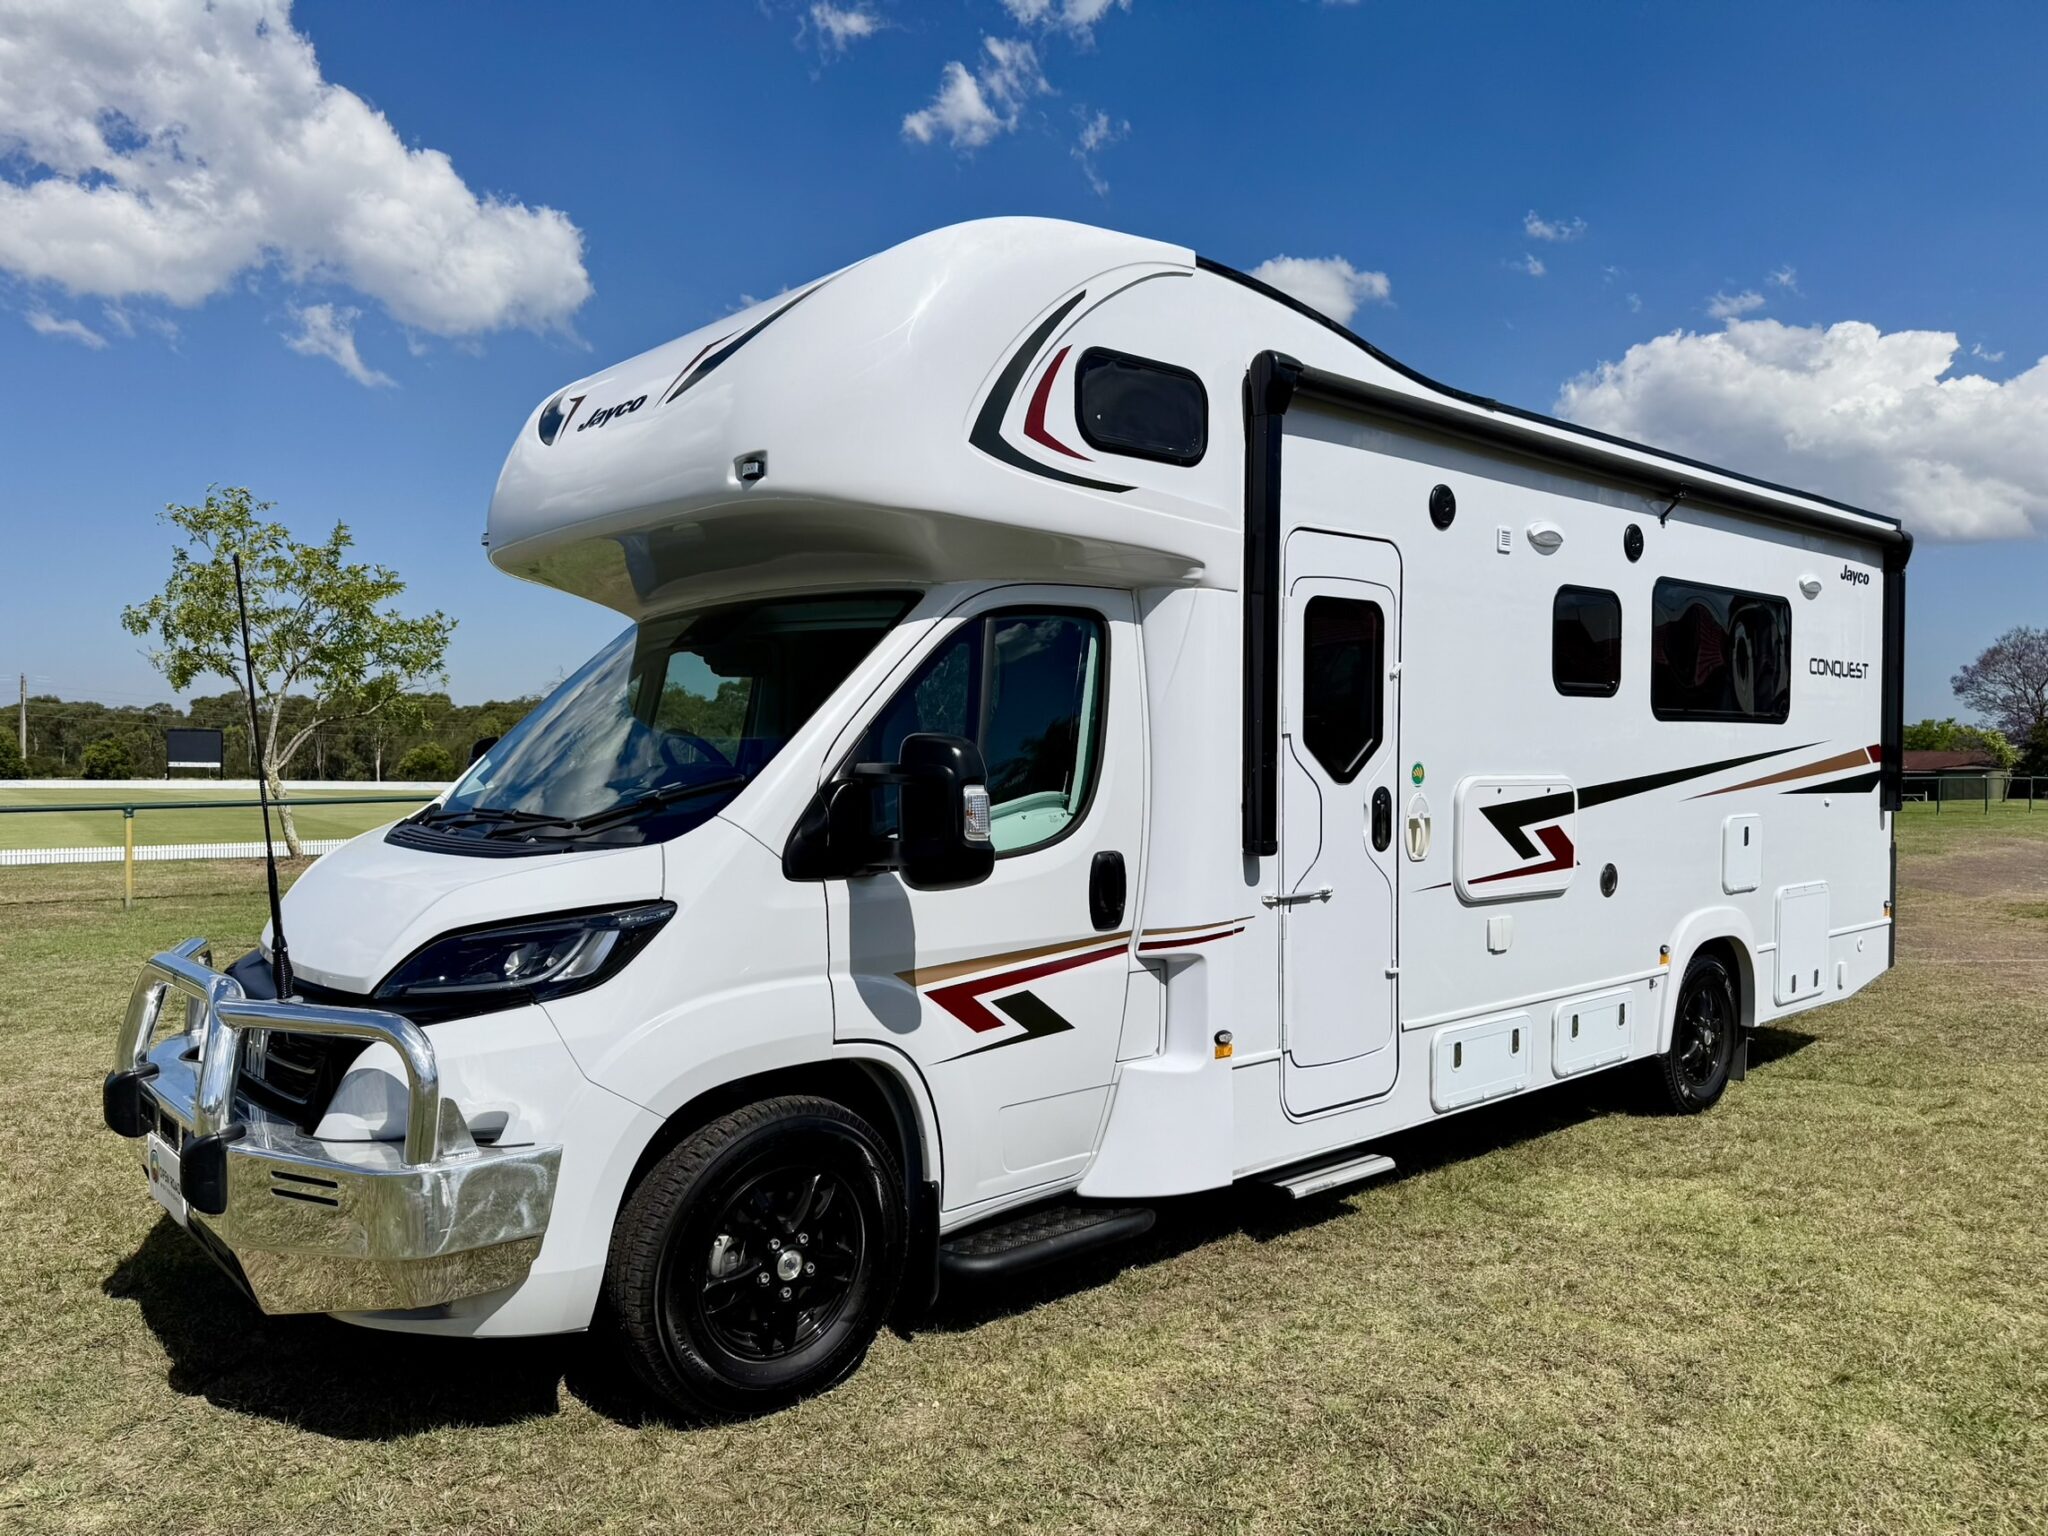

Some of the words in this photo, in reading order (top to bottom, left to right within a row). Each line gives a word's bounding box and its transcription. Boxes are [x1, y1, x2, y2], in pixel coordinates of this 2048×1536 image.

[577, 394, 648, 433] Jayco
[1840, 564, 1870, 586] Jayco
[1809, 658, 1869, 679] CONQUEST
